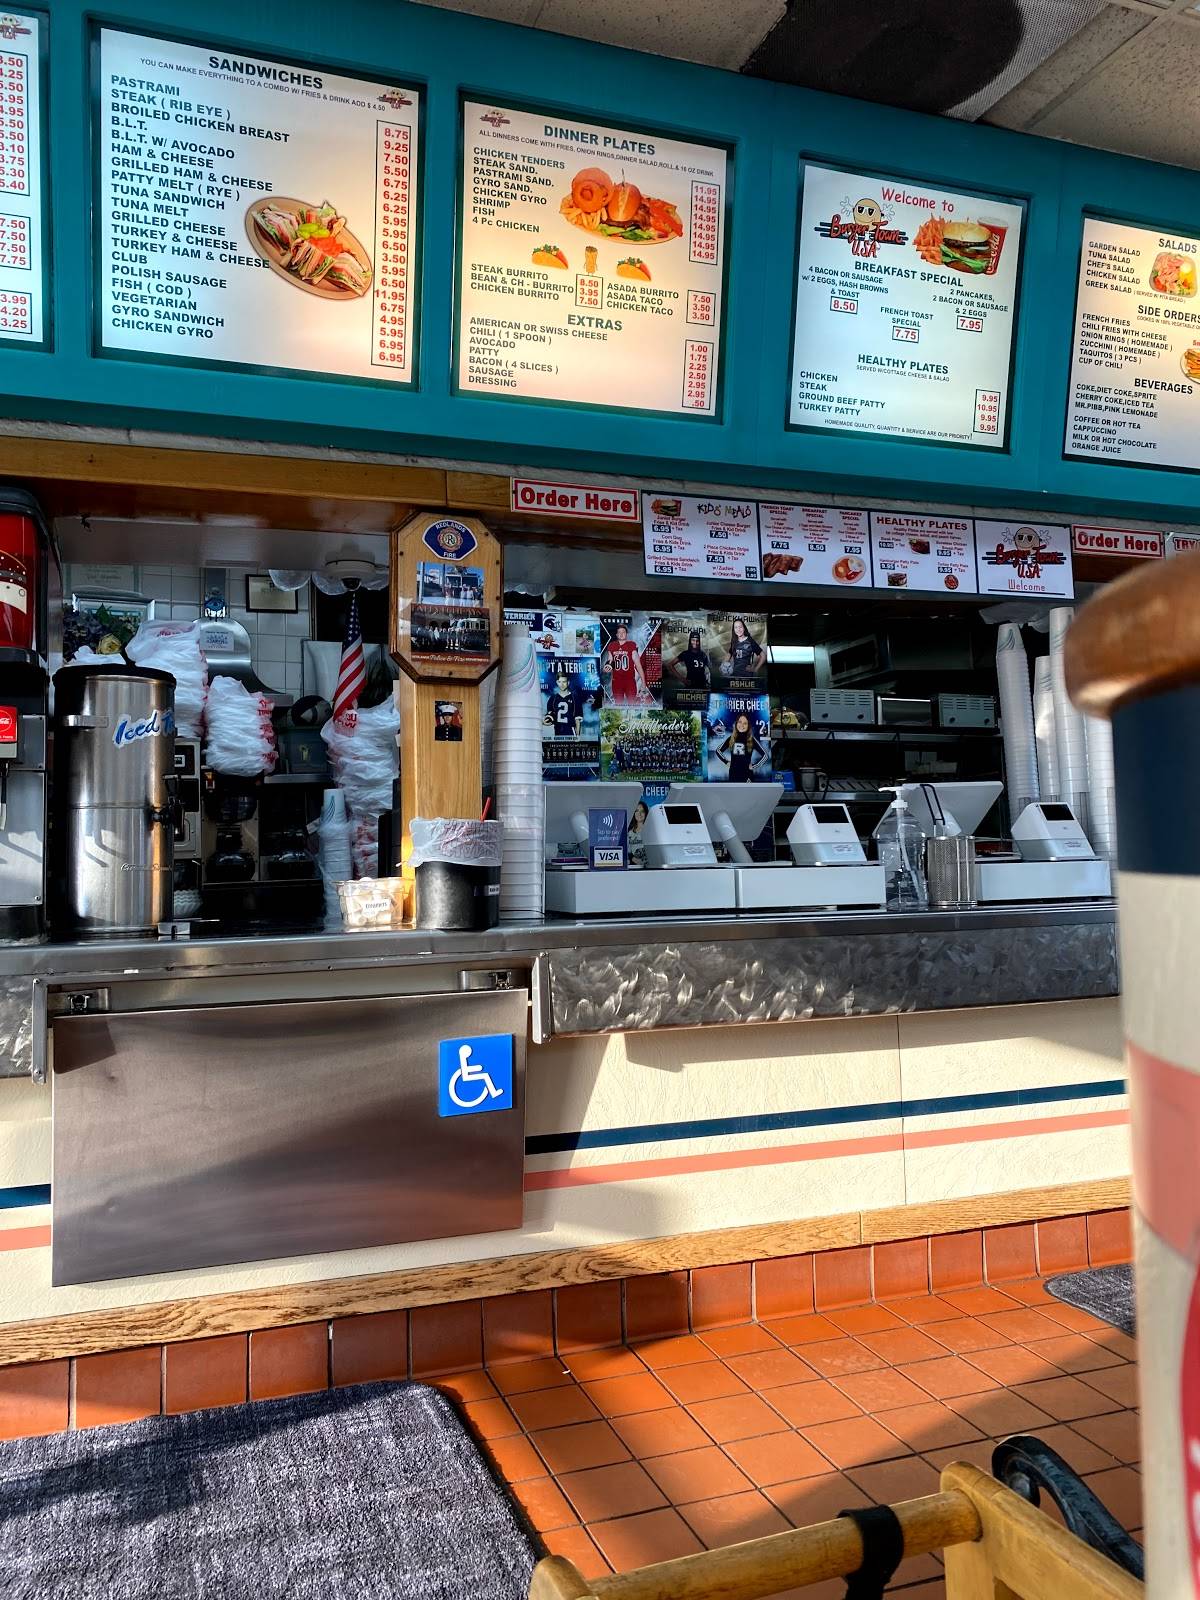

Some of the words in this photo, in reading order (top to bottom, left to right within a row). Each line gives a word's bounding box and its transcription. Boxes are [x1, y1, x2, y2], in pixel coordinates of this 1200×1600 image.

[209, 56, 323, 89] SANDWICHES
[112, 75, 179, 96] PASTRAMI
[140, 58, 156, 68] YOU
[158, 62, 174, 70] CAN
[176, 65, 198, 74] MAKE
[198, 70, 244, 84] EVERYTHING
[246, 78, 255, 86] TO
[263, 82, 290, 92] COMBO
[301, 90, 321, 98] FRIES
[329, 95, 350, 104] DRINK
[352, 100, 366, 108] ADD
[112, 102, 170, 120] BROILED
[175, 114, 234, 133] CHICKEN
[239, 126, 290, 142] BREAST
[112, 116, 147, 130] B.L.T.
[385, 128, 409, 141] 8.75
[545, 125, 598, 145] DINNER
[604, 136, 655, 155] PLATES
[112, 129, 147, 144] B.L.T.
[152, 136, 167, 147] W/
[171, 140, 234, 158] AVOCADO
[112, 143, 141, 156] HAM
[147, 149, 156, 158] &
[161, 152, 213, 168] CHEESE
[384, 153, 408, 165] 7.50
[474, 147, 517, 161] CHICKEN
[521, 155, 565, 169] TENDERS
[474, 157, 506, 169] STEAK
[509, 163, 538, 174] SAND.
[112, 157, 169, 174] GRILLED
[174, 167, 203, 180] HAM
[208, 173, 217, 182] &
[222, 175, 272, 191] CHEESE
[474, 167, 522, 181] PASTRAMI
[526, 176, 554, 187] SAND.
[474, 177, 500, 187] GYRO
[504, 182, 532, 193] SAND.
[695, 186, 717, 195] 11.95
[111, 184, 149, 198] TUNA
[154, 191, 224, 210] SANDWICH
[473, 187, 517, 200] CHICKEN
[521, 195, 547, 204] GYRO
[473, 197, 510, 208] SHRIMP
[882, 187, 935, 209] Welcome
[942, 200, 954, 212] to
[111, 197, 149, 211] TUNA
[154, 204, 189, 217] MELT
[473, 206, 494, 216] FISH
[112, 211, 169, 227] GRILLED
[174, 221, 225, 236] CHEESE
[496, 220, 539, 232] CHICKEN
[831, 214, 869, 243] Burger
[872, 220, 902, 243] Town
[111, 224, 167, 240] TURKEY
[172, 233, 181, 242] &
[186, 236, 237, 251] CHEESE
[1089, 242, 1117, 252] GARDEN
[1119, 247, 1140, 256] SALAD
[1159, 239, 1197, 253] SALADS
[112, 251, 147, 264] CLUB
[382, 253, 405, 264] 3.50
[1088, 251, 1106, 259] TUNA
[1109, 255, 1130, 263] SALAD
[112, 265, 160, 279] POLISH
[166, 272, 227, 288] SAUSAGE
[472, 264, 503, 274] STEAK
[507, 269, 548, 280] BURRITO
[855, 261, 917, 279] BREAKFAST
[920, 272, 963, 287] SPECIAL
[1087, 269, 1117, 280] CHICKEN
[1119, 275, 1140, 284] SALAD
[374, 288, 406, 303] 11.95
[471, 282, 514, 294] CHICKEN
[518, 289, 559, 300] BURRITO
[607, 283, 637, 293] ASADA
[640, 288, 679, 298] BURRITO
[112, 291, 196, 310] VEGETARIAN
[607, 292, 637, 302] ASADA
[640, 296, 663, 305] TACO
[834, 300, 855, 311] 8.50
[607, 301, 647, 312] CHICKEN
[650, 307, 673, 315] TACO
[881, 307, 909, 316] FRENCH
[911, 312, 933, 320] TOAST
[1138, 305, 1160, 316] SIDE
[112, 305, 149, 317] GYRO
[154, 310, 224, 327] SANDWICH
[568, 315, 622, 331] EXTRAS
[892, 318, 921, 327] SPECIAL
[1083, 313, 1109, 323] FRENCH
[1112, 318, 1130, 326] FRIES
[112, 318, 172, 333] CHICKEN
[177, 326, 213, 338] GYRO
[960, 319, 982, 331] 7.95
[894, 329, 916, 340] 7.75
[470, 337, 515, 348] AVOCADO
[470, 347, 499, 356] PATTY
[469, 366, 513, 377] SAUSAGE
[858, 355, 906, 368] HEALTHY
[910, 362, 948, 374] PLATES
[469, 376, 517, 387] DRESSING
[800, 371, 837, 382] CHICKEN
[800, 381, 827, 391] STEAK
[1134, 379, 1192, 394] BEVERAGES
[799, 392, 834, 402] GROUND
[837, 397, 857, 405] BEEF
[860, 400, 885, 408] PATTY
[798, 402, 832, 412] TURKEY
[835, 407, 860, 416] PATTY
[1073, 425, 1116, 435] CAPPUCCINO
[1072, 442, 1100, 451] ORANGE
[521, 487, 578, 508] Order
[586, 493, 632, 512] Here
[436, 522, 466, 532] REDLANDS
[877, 516, 925, 527] HEALTHY
[929, 521, 967, 530] PLATES
[1078, 532, 1119, 548] Order
[1125, 536, 1157, 551] Here
[1008, 579, 1045, 591] Welcome
[557, 702, 568, 723] 2
[116, 712, 159, 744] Iced
